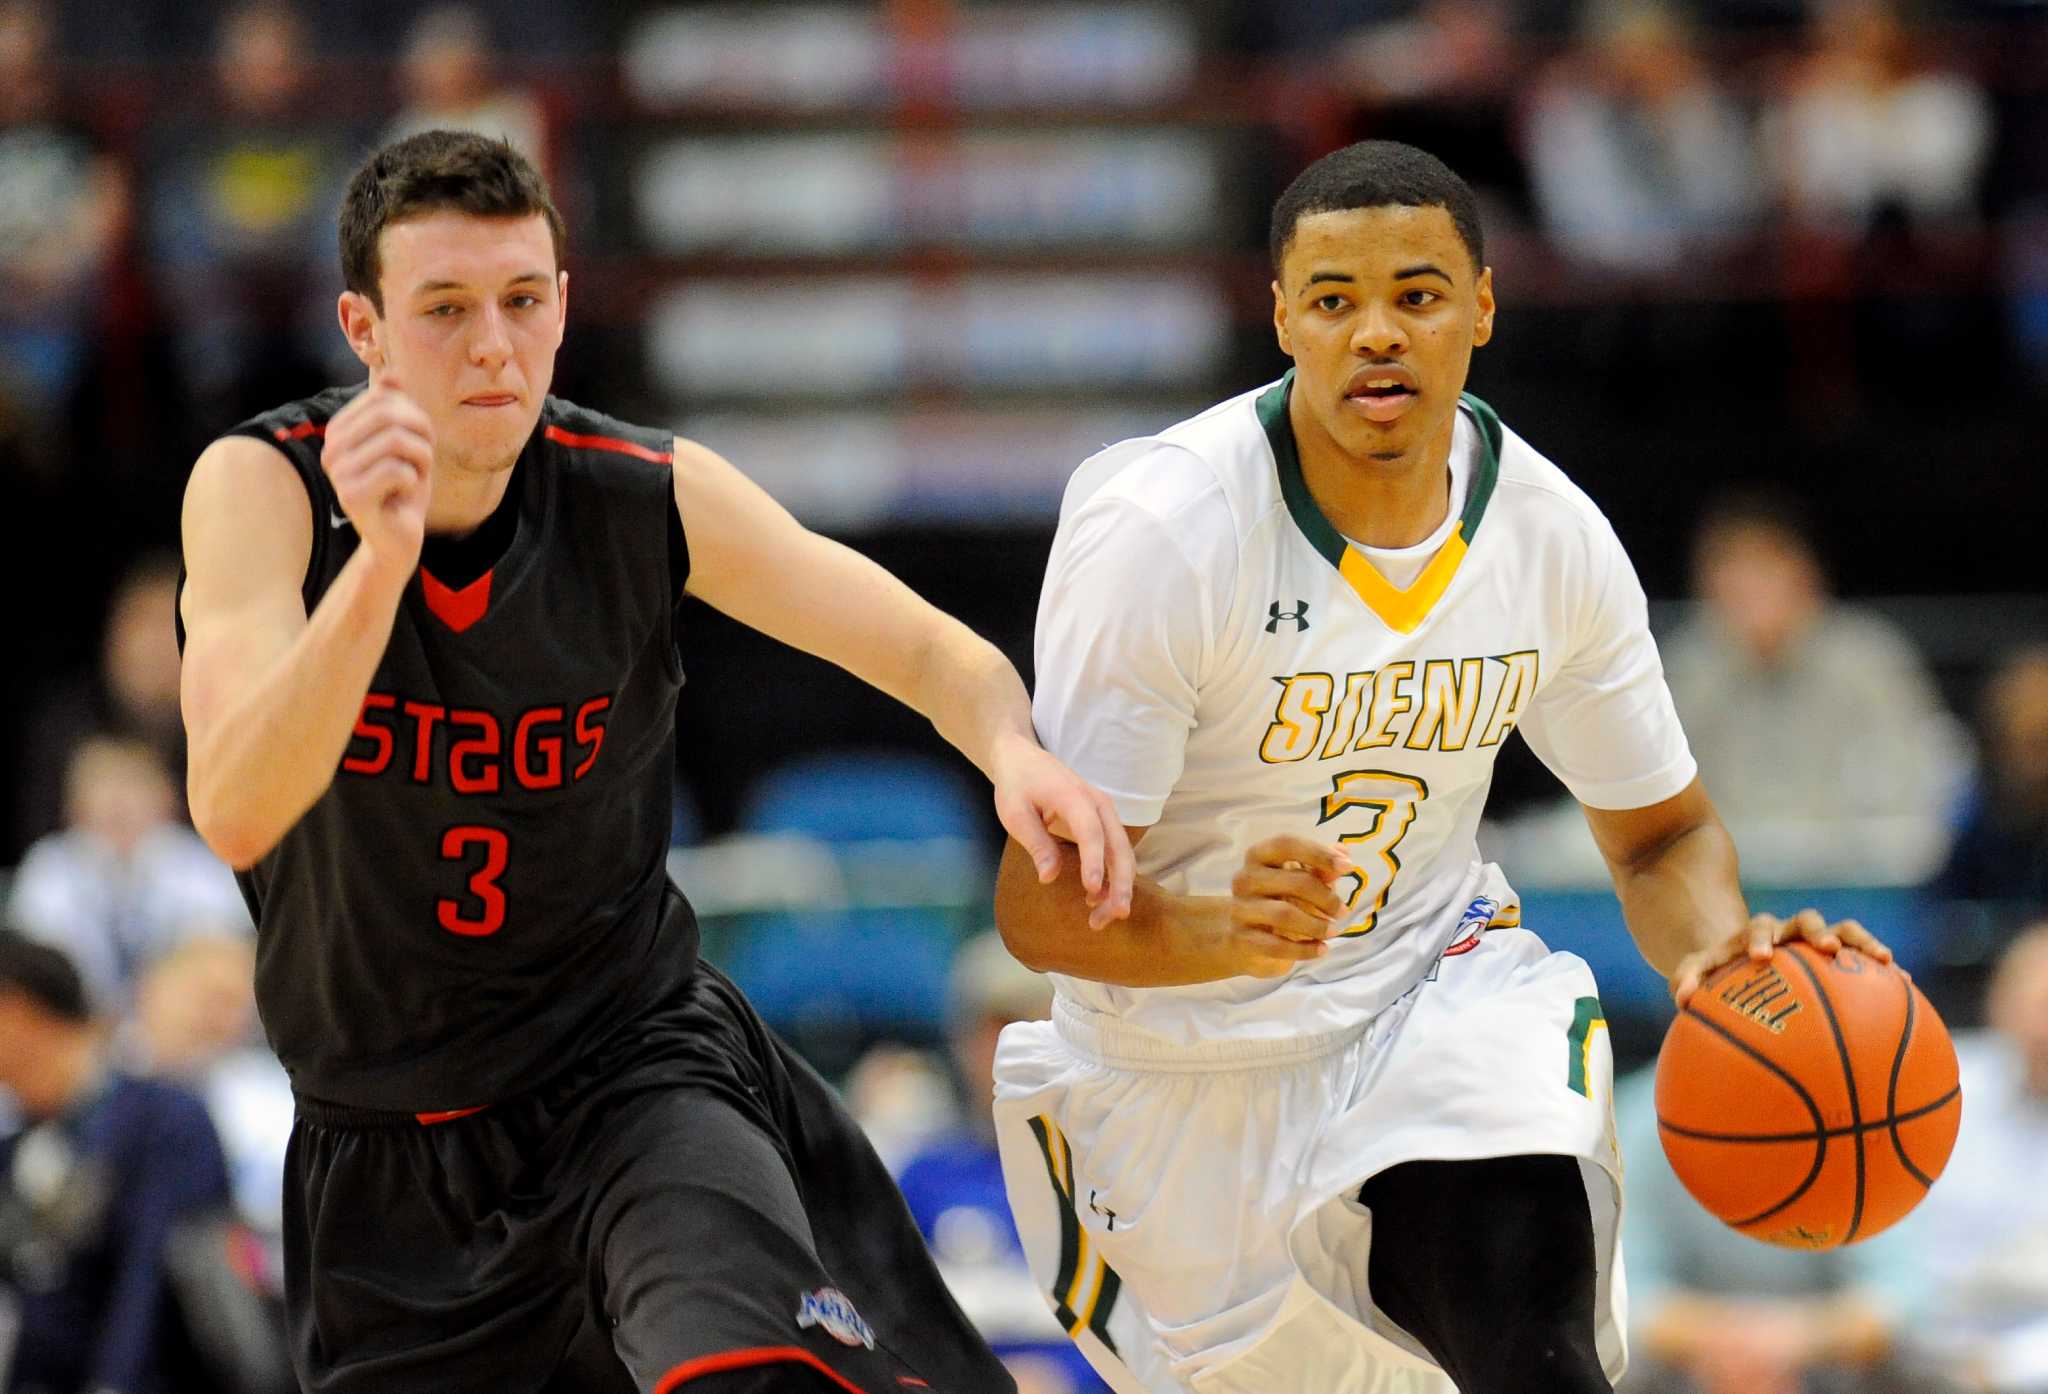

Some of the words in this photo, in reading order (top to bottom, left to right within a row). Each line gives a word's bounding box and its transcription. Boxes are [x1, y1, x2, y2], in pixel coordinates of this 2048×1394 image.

[343, 693, 611, 795] STAGS
[1258, 649, 1540, 764] SIENA
[437, 825, 509, 937] 3
[1316, 768, 1430, 938] 3
